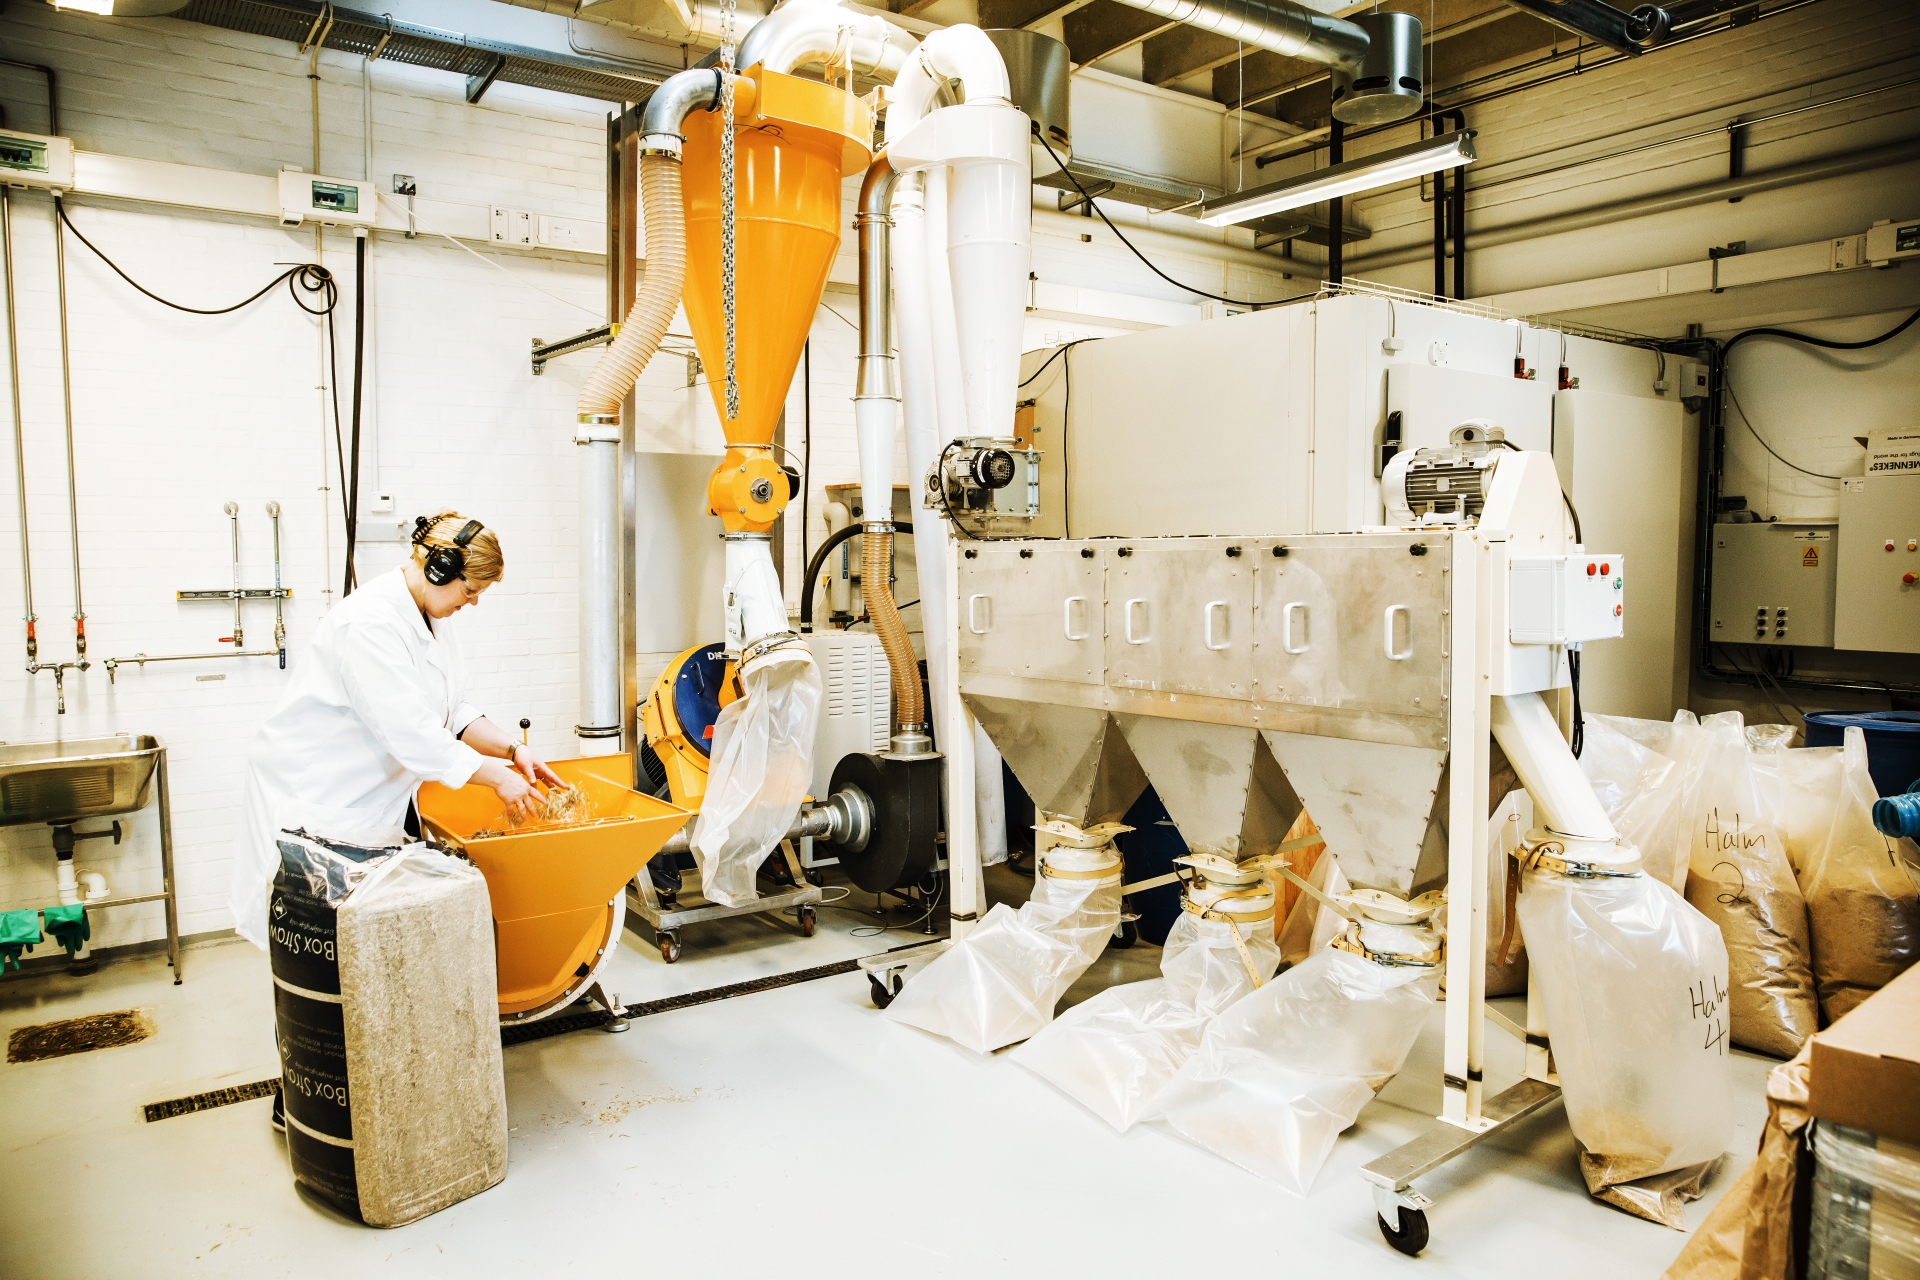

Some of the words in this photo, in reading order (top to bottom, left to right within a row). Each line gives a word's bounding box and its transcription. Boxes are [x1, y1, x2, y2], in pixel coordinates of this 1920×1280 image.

[1705, 807, 1766, 852] Halm
[1711, 861, 1751, 904] 2
[270, 924, 302, 954] Straw
[303, 935, 335, 961] Box
[1704, 1018, 1727, 1056] 4
[314, 1080, 347, 1107] Box
